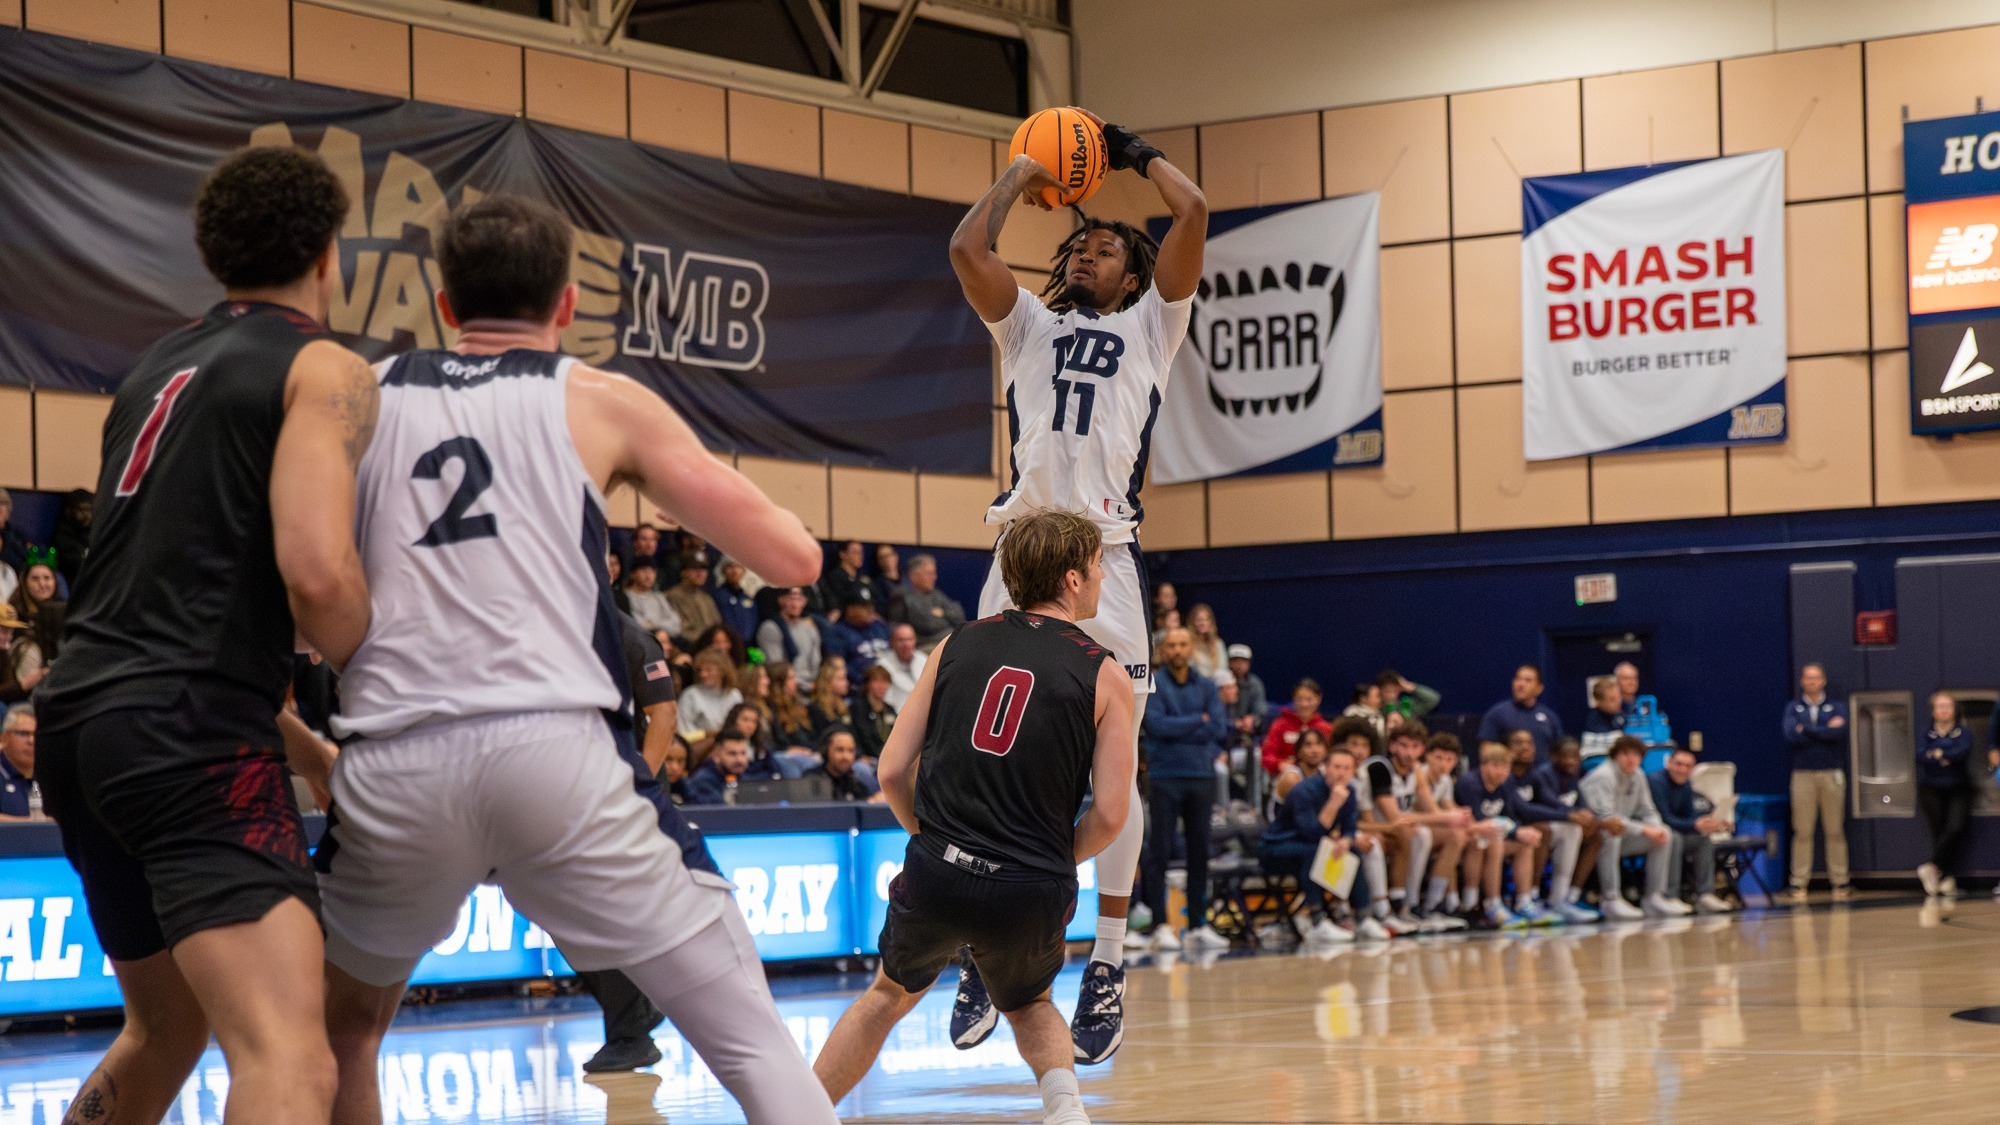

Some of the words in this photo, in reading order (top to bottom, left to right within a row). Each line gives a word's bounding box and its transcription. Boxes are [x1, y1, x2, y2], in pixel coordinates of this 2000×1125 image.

[1068, 123, 1088, 188] Wilson
[1547, 237, 1754, 294] SMASH
[622, 243, 770, 371] MB
[1548, 288, 1757, 343] BURGER
[1052, 327, 1125, 386] MB
[1573, 355, 1651, 377] BURGER
[1656, 350, 1731, 370] BETTER
[115, 366, 198, 497] 1
[1052, 378, 1095, 436] 11
[1728, 404, 1786, 440] MB
[1332, 429, 1383, 465] MB
[411, 435, 499, 547] 2
[971, 665, 1035, 757] 0
[733, 865, 839, 935] BAY
